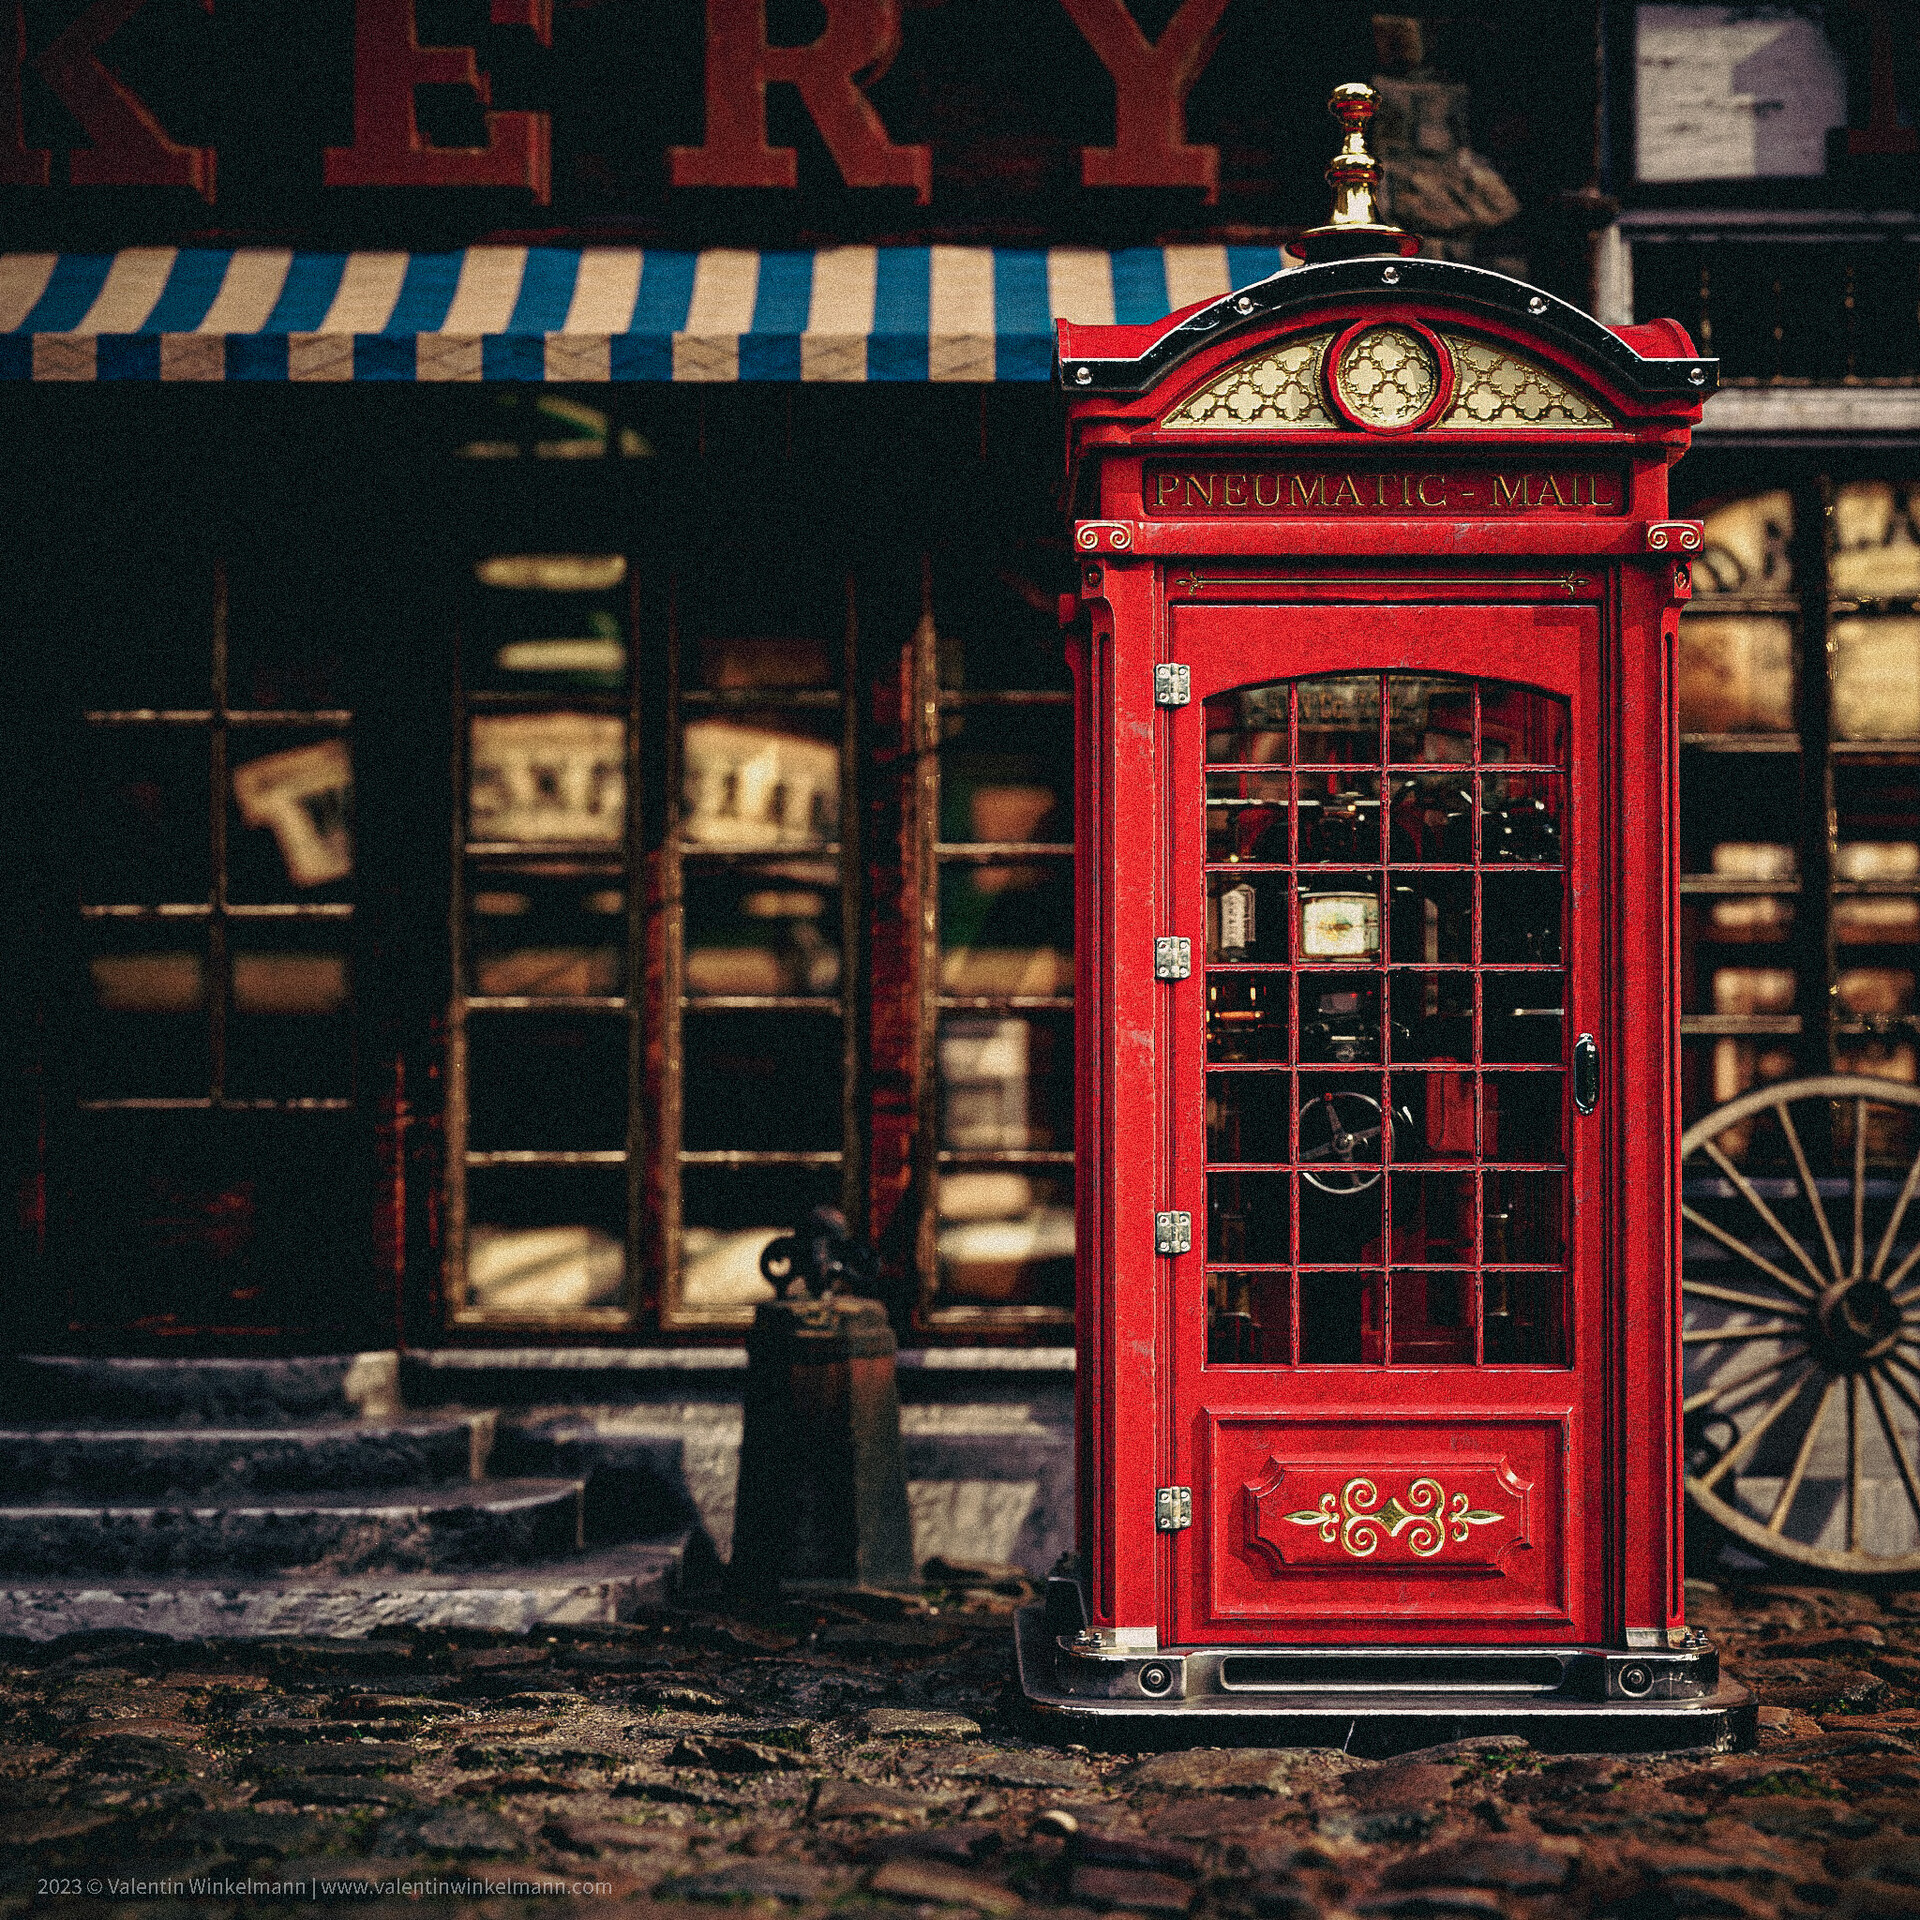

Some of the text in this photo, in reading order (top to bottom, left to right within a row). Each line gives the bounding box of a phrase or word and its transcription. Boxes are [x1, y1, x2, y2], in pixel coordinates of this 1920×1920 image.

[0, 0, 1220, 203] KERY
[1153, 473, 1447, 507] PNEUMATIC
[1489, 473, 1614, 507] MAIL
